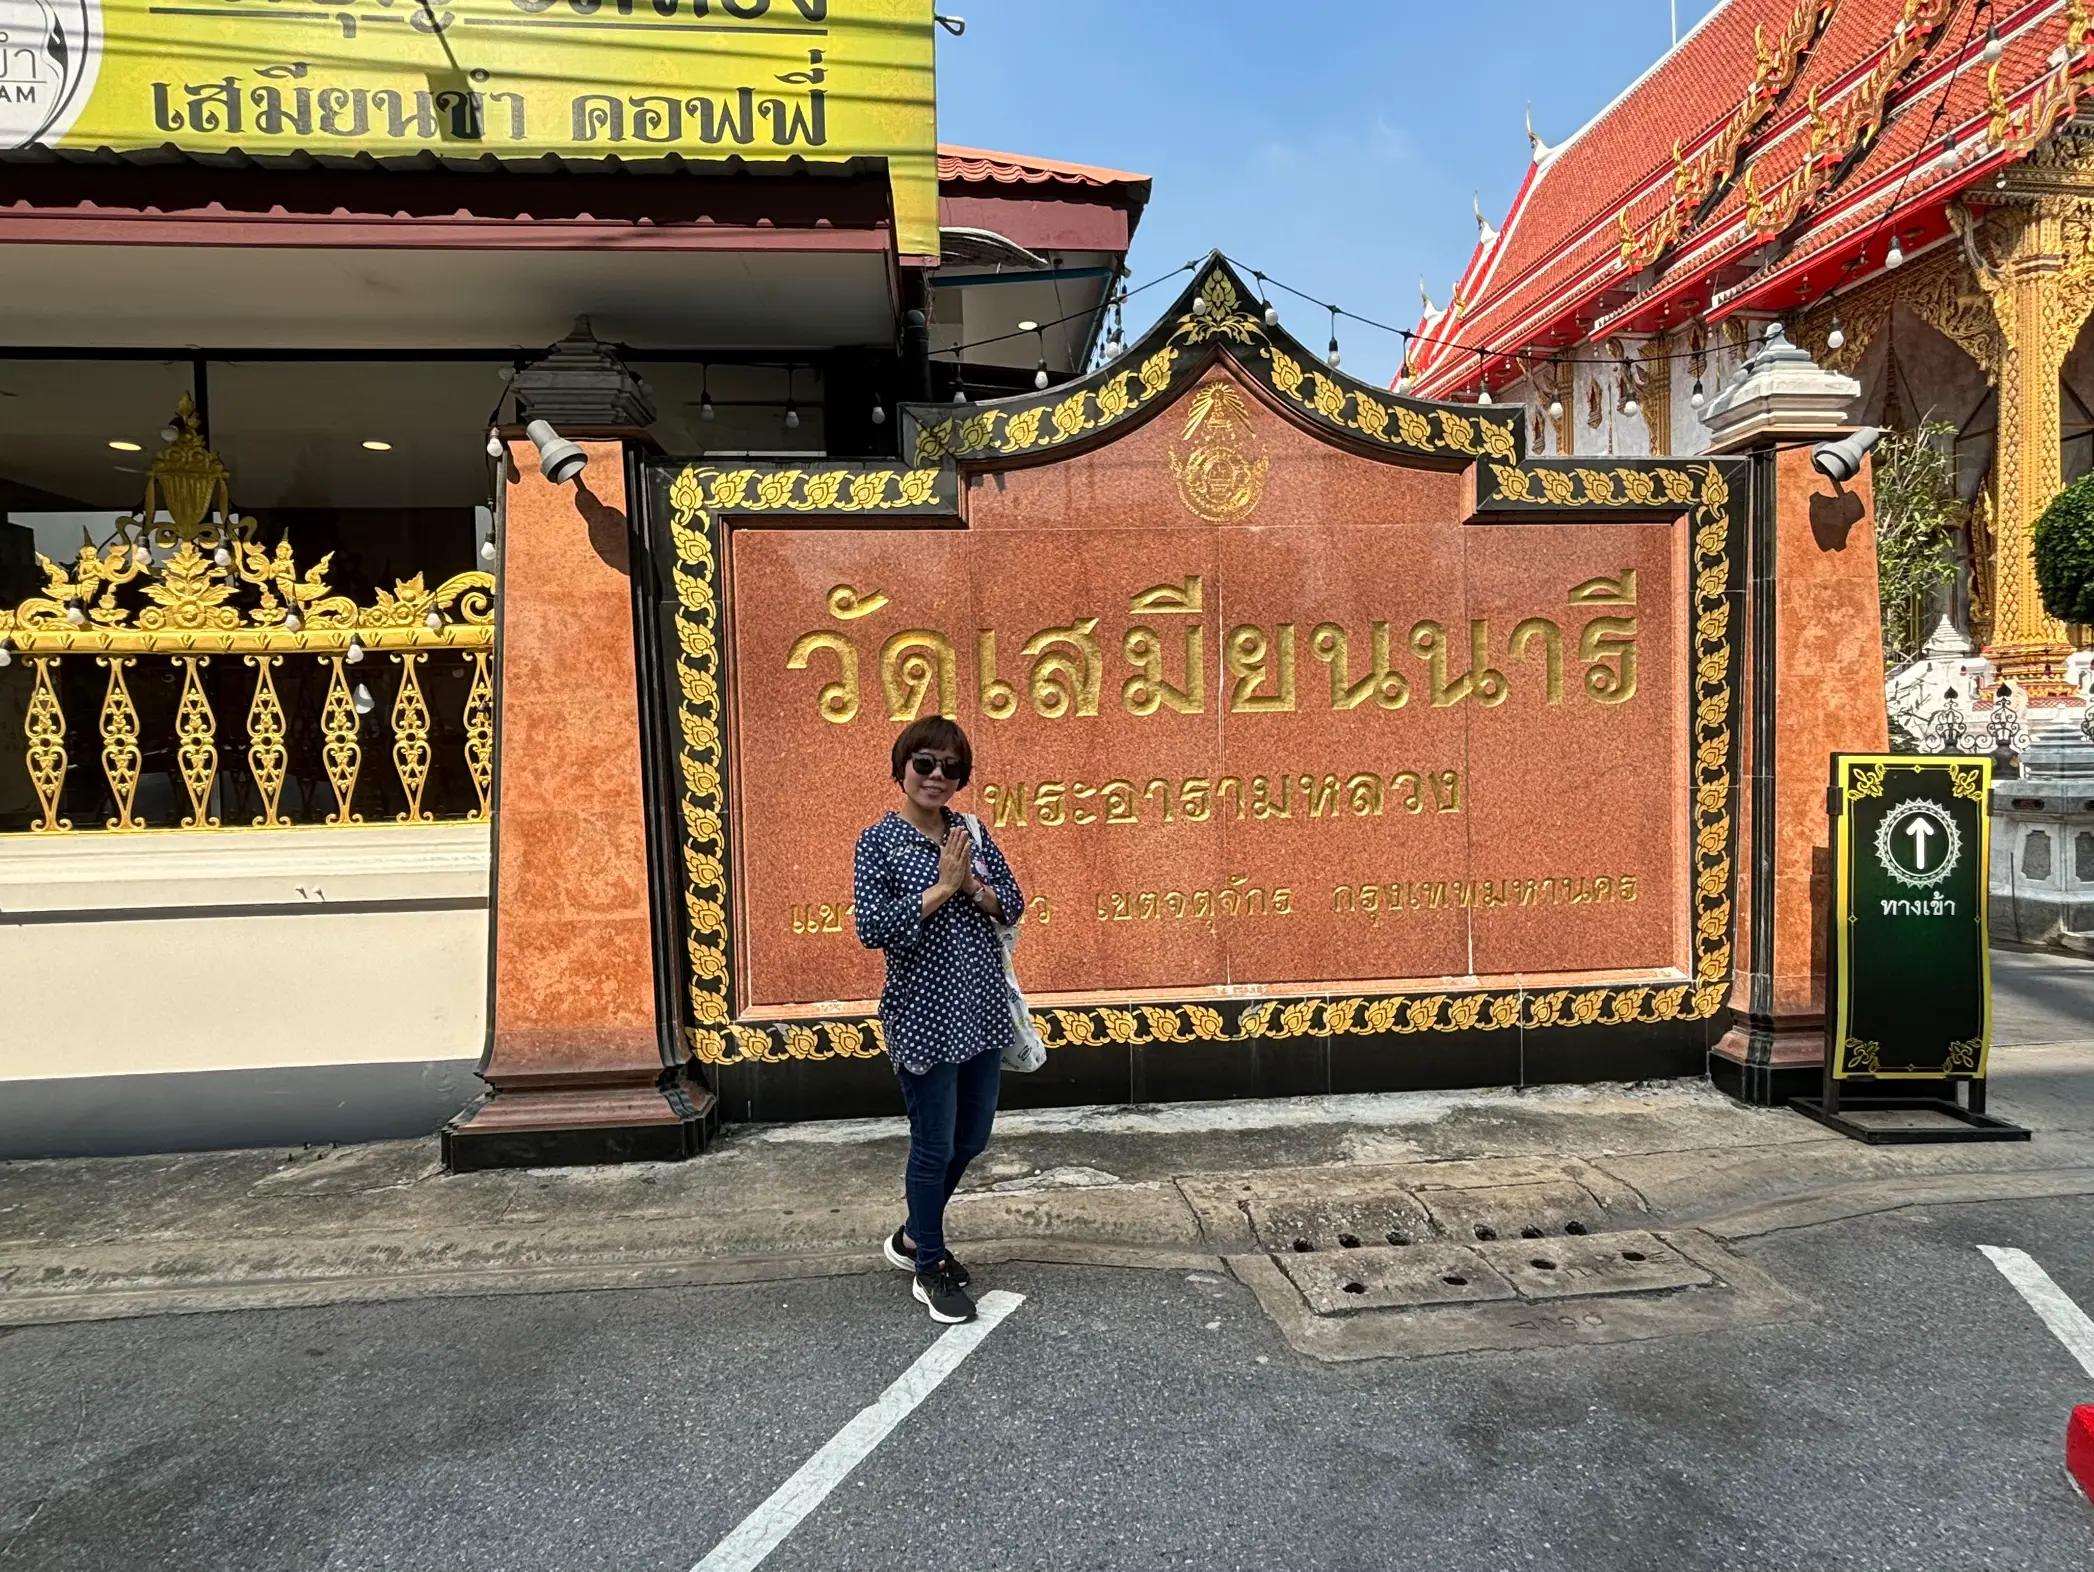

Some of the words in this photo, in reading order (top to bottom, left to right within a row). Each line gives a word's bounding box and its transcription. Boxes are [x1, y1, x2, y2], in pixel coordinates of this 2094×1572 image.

[151, 62, 529, 140] เสมียนขำ
[571, 48, 829, 146] คอฟฟี่
[786, 569, 1637, 724] วัดเสมียนนารี
[983, 769, 1461, 828] พระอารามหลวง
[1096, 875, 1294, 933] เขตจตุจักร
[1332, 873, 1638, 928] กรุงเทพมหานคร
[1880, 890, 1956, 916] ทางเข้า
